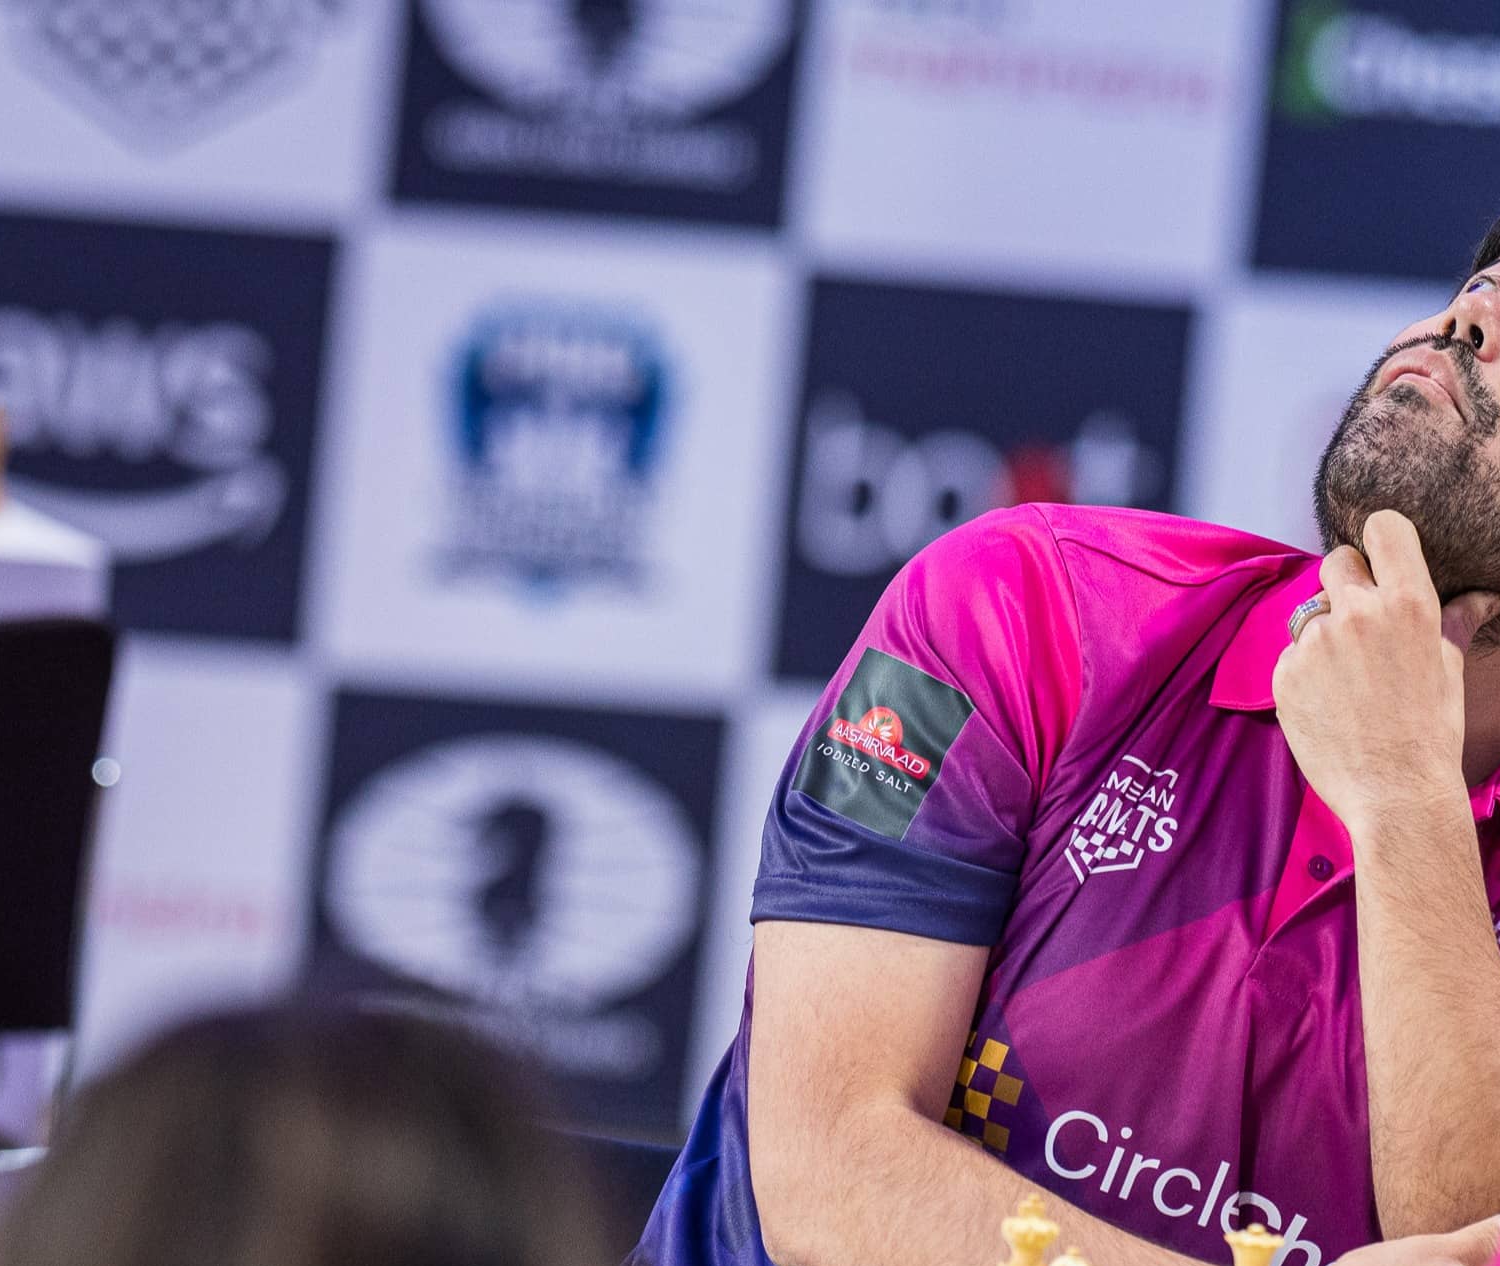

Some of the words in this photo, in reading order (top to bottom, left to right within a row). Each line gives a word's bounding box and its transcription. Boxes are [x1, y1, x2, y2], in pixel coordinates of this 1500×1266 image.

[817, 743, 870, 773] IODIZED
[875, 770, 912, 793] SALT
[835, 722, 925, 774] AASHIRVAAD
